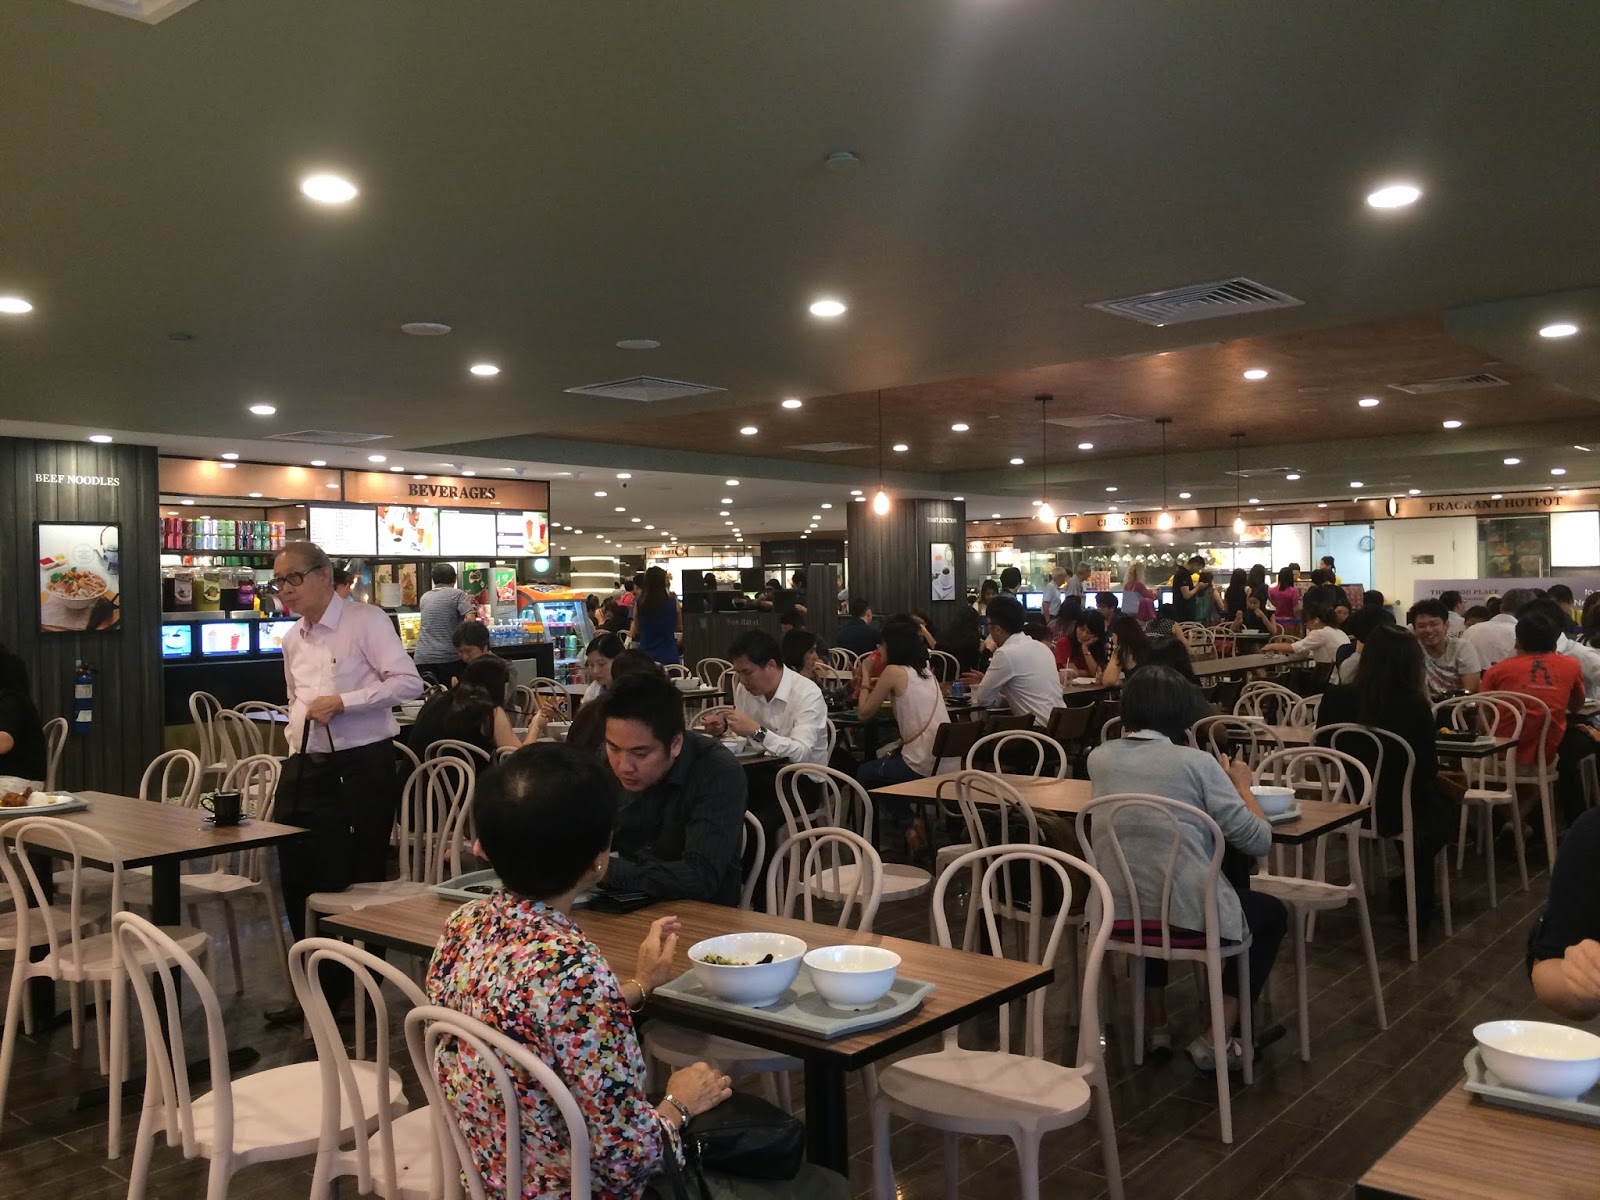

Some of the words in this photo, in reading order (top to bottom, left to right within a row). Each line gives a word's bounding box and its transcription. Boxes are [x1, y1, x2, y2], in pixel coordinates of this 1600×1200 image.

[35, 473, 65, 484] BEEF
[67, 475, 120, 487] NOODLES
[408, 483, 496, 500] BEVERAGES
[1429, 500, 1499, 511] FRAGRANT
[1505, 496, 1562, 508] HOTPOT
[1097, 517, 1129, 527] CH'S
[1130, 516, 1152, 526] FISH
